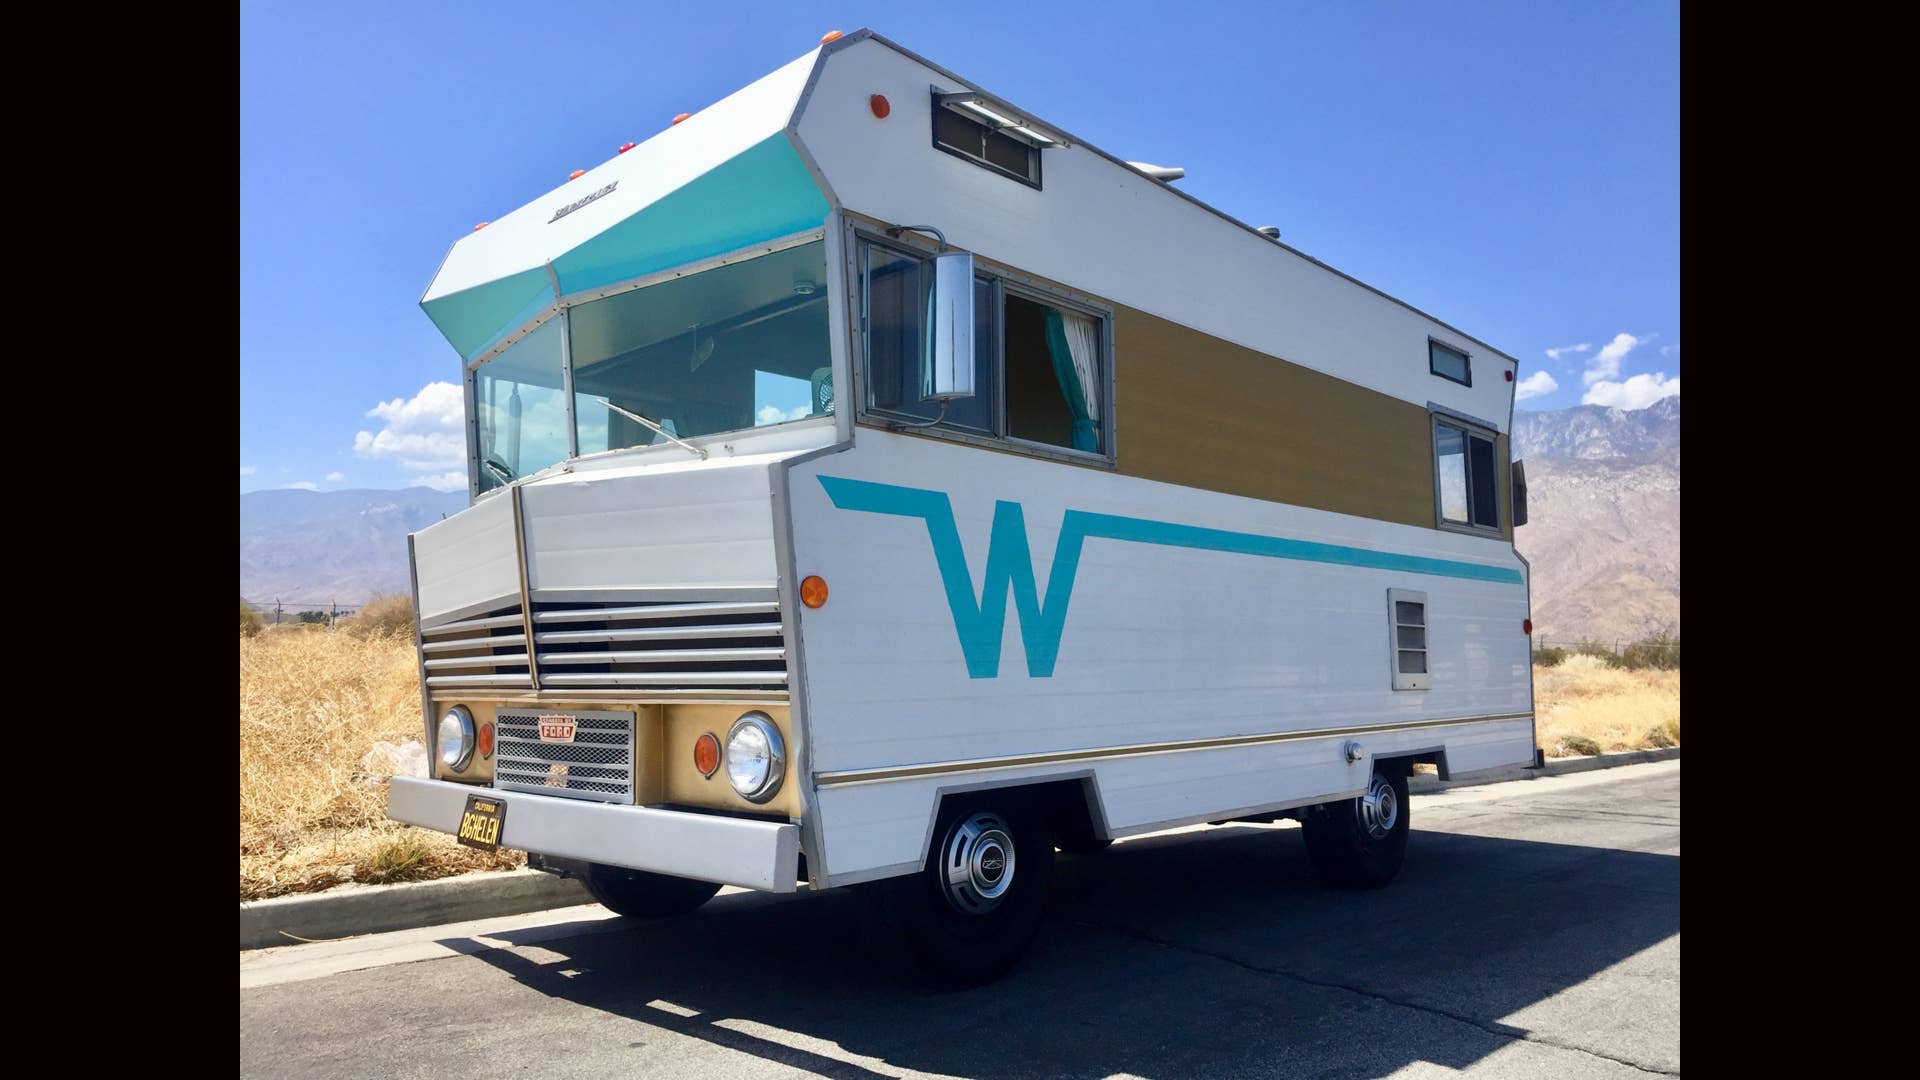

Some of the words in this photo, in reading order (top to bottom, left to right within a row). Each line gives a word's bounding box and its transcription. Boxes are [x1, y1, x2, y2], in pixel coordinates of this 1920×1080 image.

[925, 493, 1085, 678] W
[543, 726, 571, 737] FORD
[460, 812, 500, 845] BGHELEN
